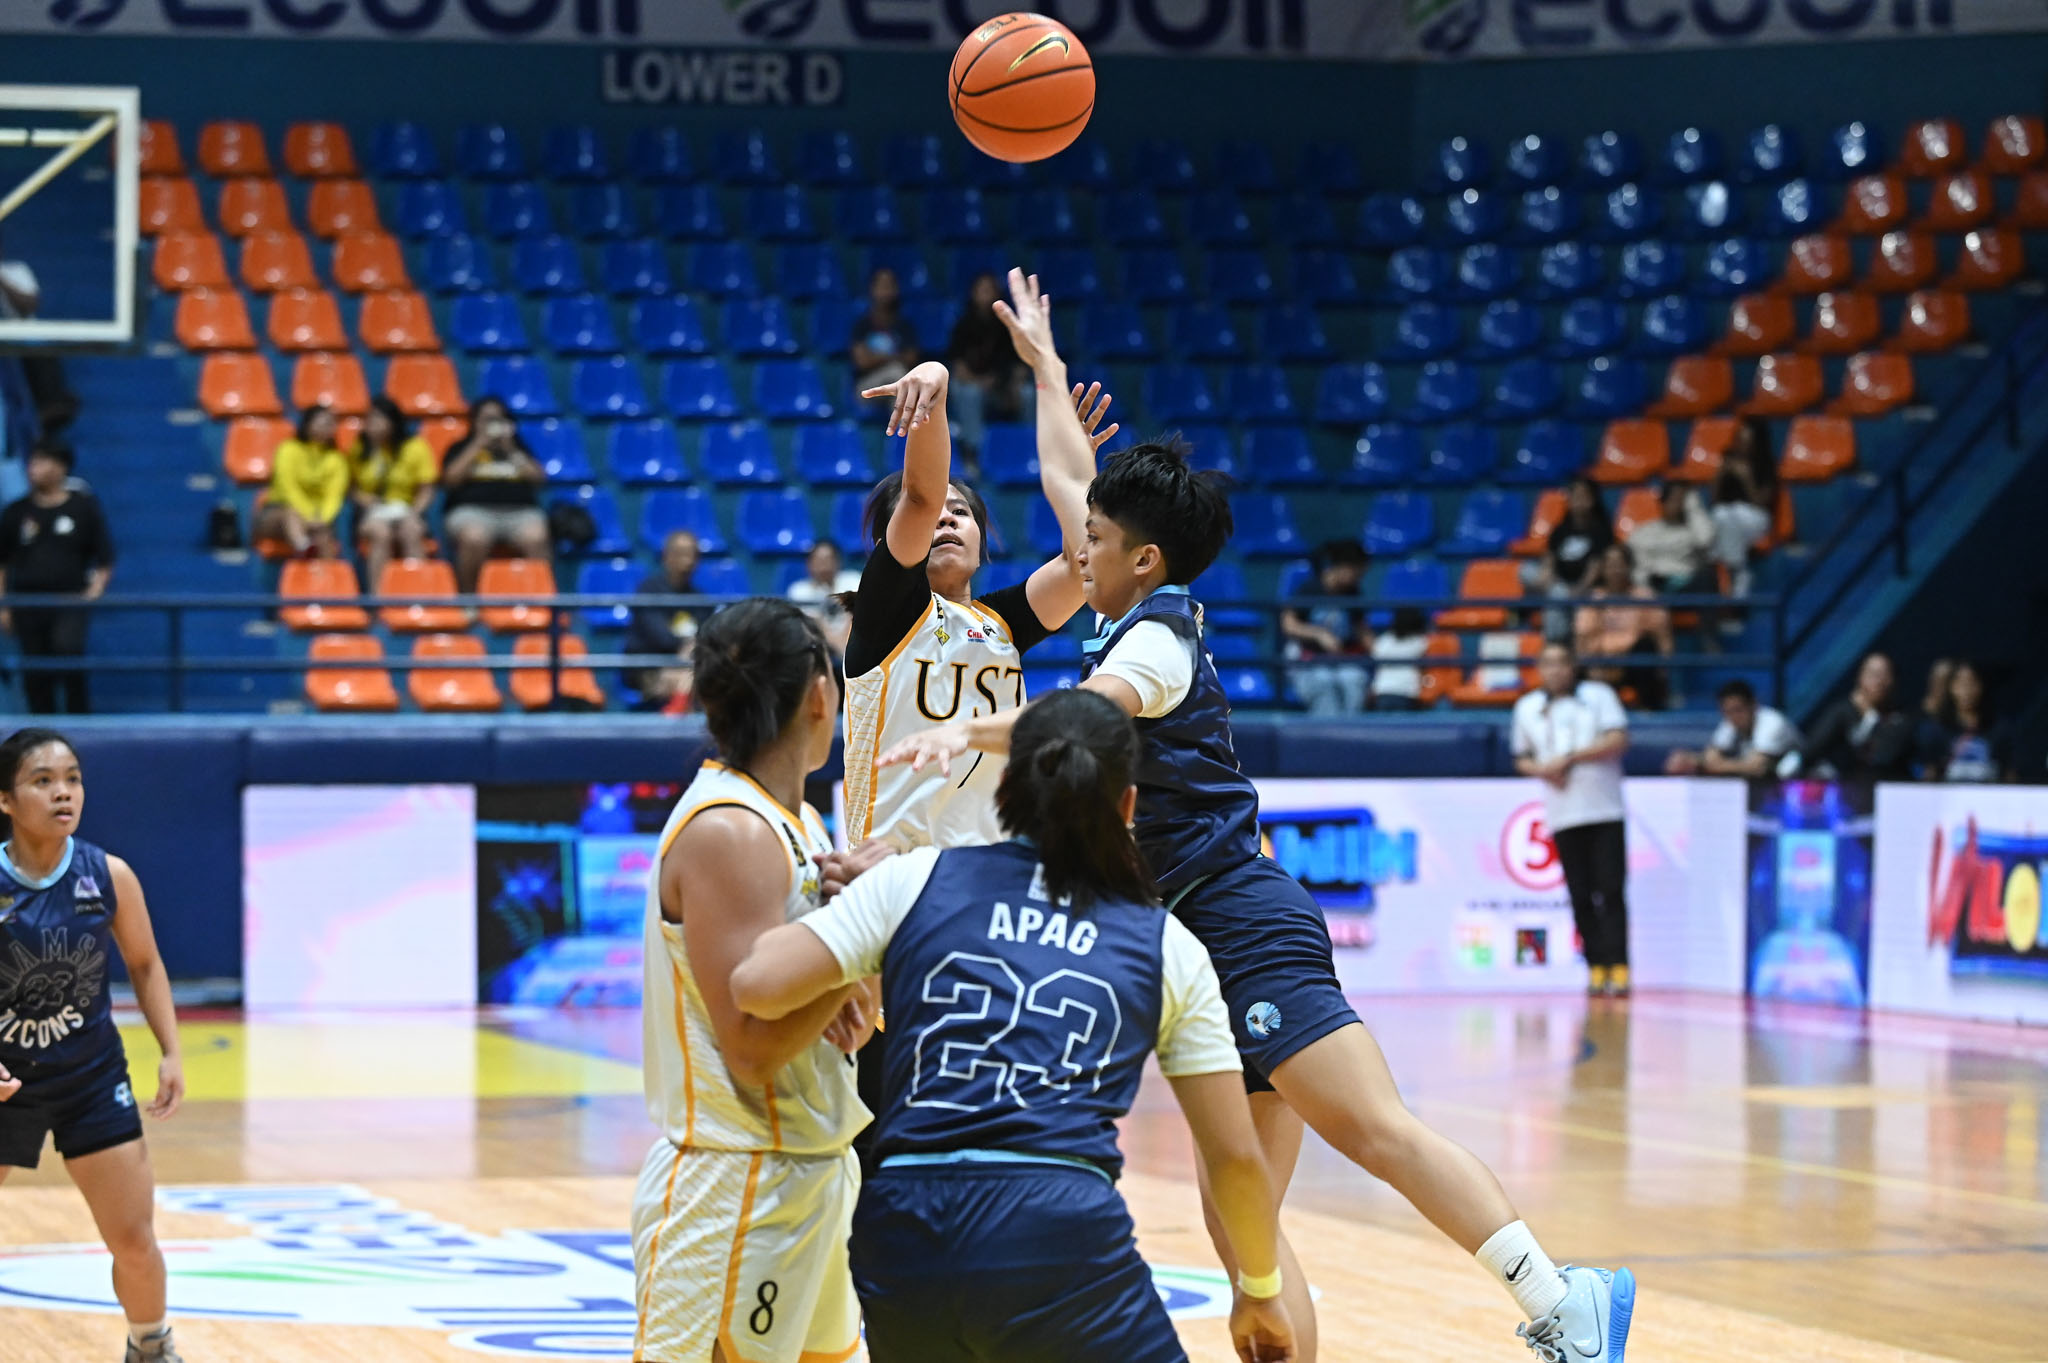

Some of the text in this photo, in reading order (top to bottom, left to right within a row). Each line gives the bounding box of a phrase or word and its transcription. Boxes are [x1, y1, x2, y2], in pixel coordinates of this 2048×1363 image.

[603, 52, 843, 104] LOWER D
[914, 657, 1023, 723] UST
[987, 902, 1098, 956] APAG
[0, 1005, 84, 1049] ALCONS
[906, 951, 1122, 1109] 23
[749, 1280, 779, 1335] 8
